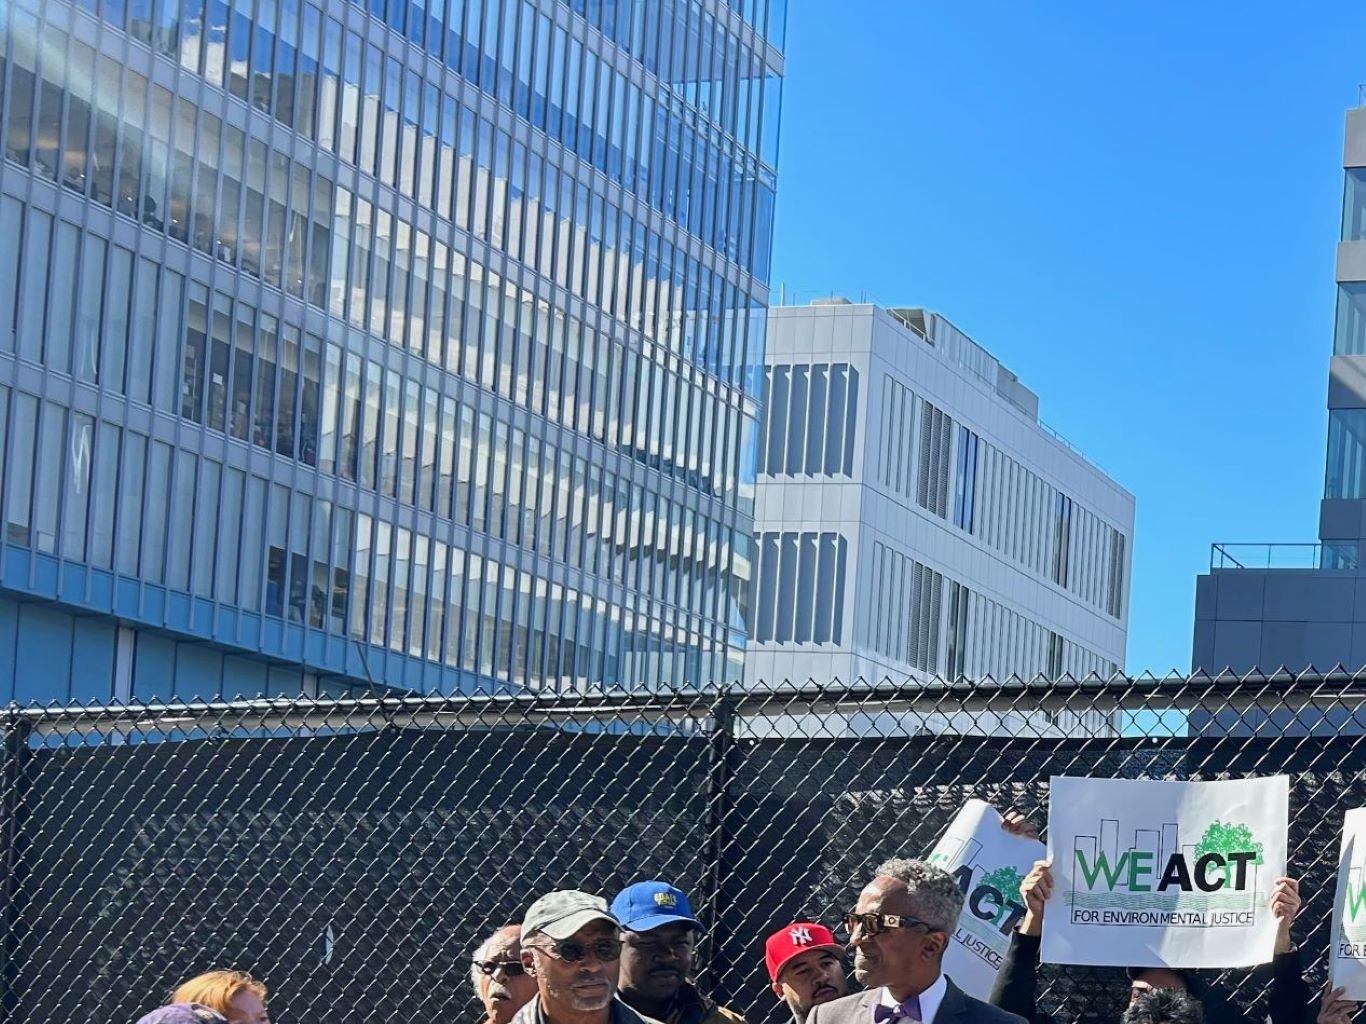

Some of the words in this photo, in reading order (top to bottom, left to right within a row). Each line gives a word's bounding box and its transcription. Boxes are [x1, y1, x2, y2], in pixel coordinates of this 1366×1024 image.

[1074, 849, 1153, 891] WE
[1157, 851, 1257, 892] ACT
[1074, 909, 1099, 923] FOR
[1103, 911, 1208, 924] ENVIRONMENTAL
[1210, 912, 1253, 925] JUSTICE
[960, 934, 1003, 965] JUSTICE
[1339, 943, 1361, 958] FOR
